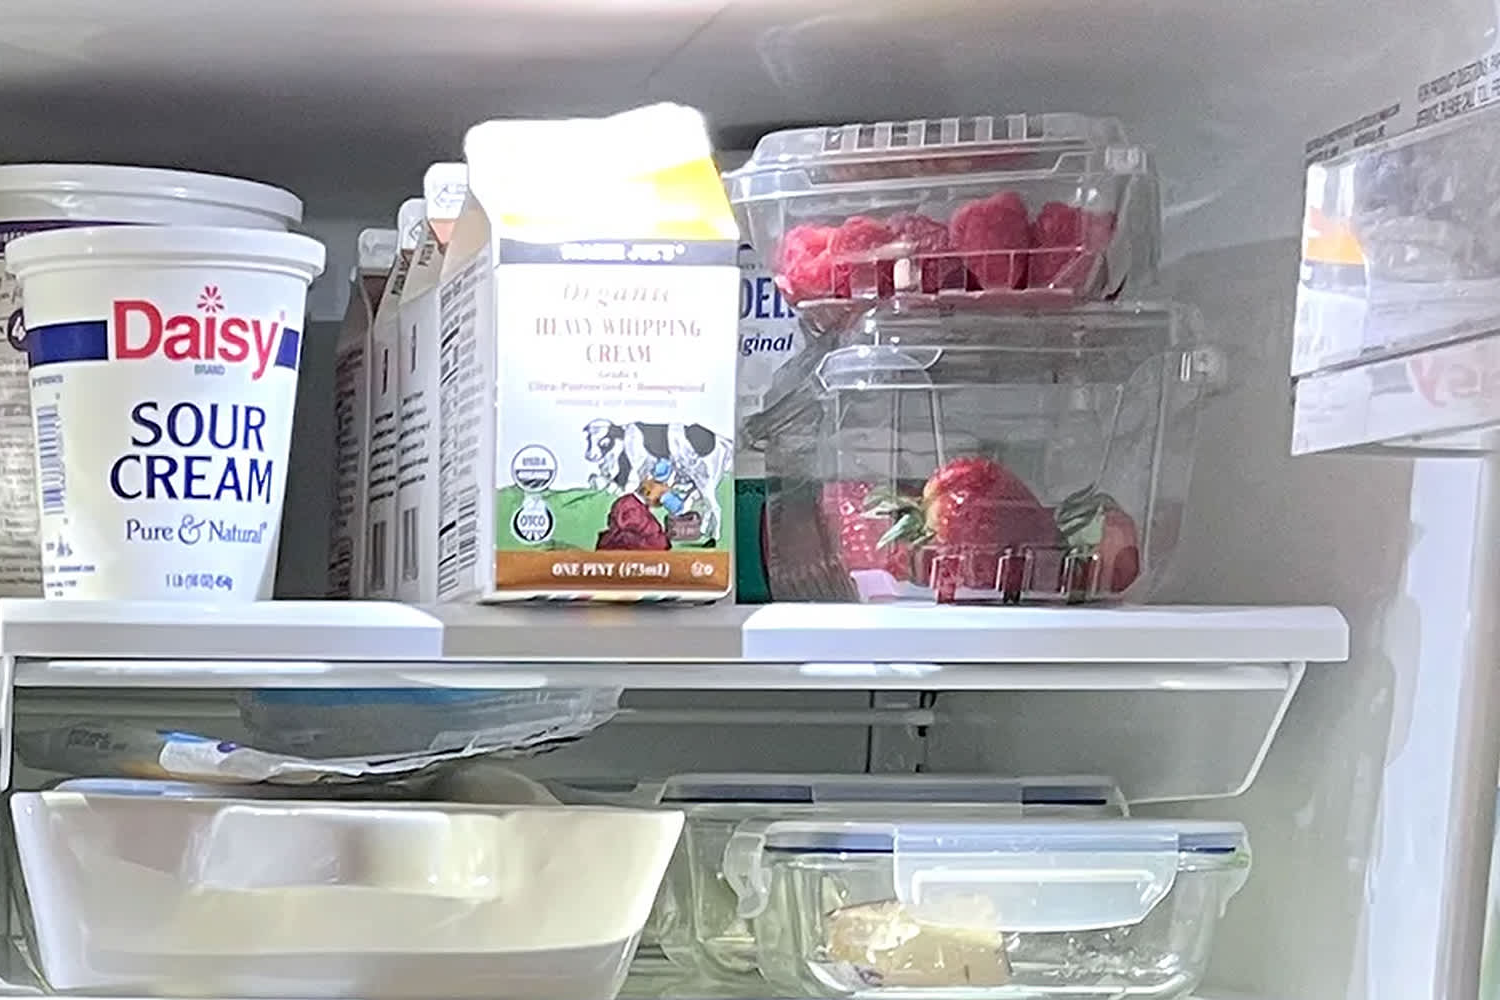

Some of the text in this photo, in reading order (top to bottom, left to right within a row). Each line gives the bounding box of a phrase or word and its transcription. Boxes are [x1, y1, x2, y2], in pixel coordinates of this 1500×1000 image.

[740, 277, 795, 319] DEL
[113, 286, 278, 380] Daisy
[603, 318, 701, 337] WHIPPING
[585, 343, 651, 363] CREAM
[131, 402, 266, 452] SOUR
[110, 454, 273, 504] CREAM
[127, 513, 263, 545] Pure & Natural
[552, 563, 579, 577] ONE
[583, 563, 613, 577] PINT
